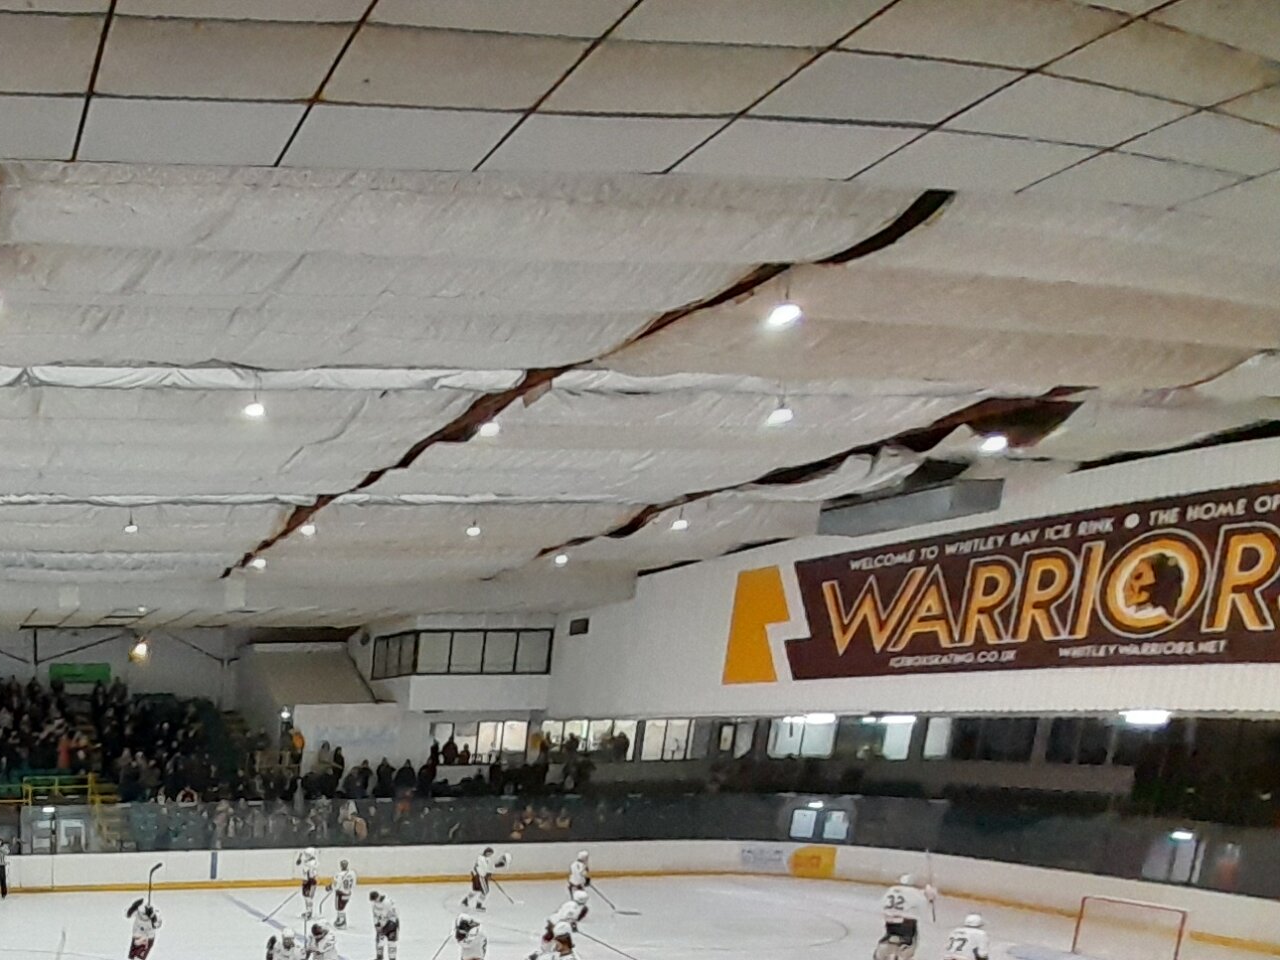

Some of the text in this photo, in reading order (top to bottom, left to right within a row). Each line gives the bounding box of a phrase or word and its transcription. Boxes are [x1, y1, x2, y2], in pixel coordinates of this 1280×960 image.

[850, 549, 916, 571] WELCOME
[920, 545, 939, 560] TO
[945, 534, 1006, 555] WHITLEY
[1010, 527, 1041, 546] BAY
[1045, 523, 1072, 540] ICE
[1078, 517, 1115, 536] RINK
[1149, 507, 1181, 526] THE
[1186, 496, 1248, 522] HOME
[821, 521, 1280, 656] WARRIOR
[884, 894, 905, 911] 32
